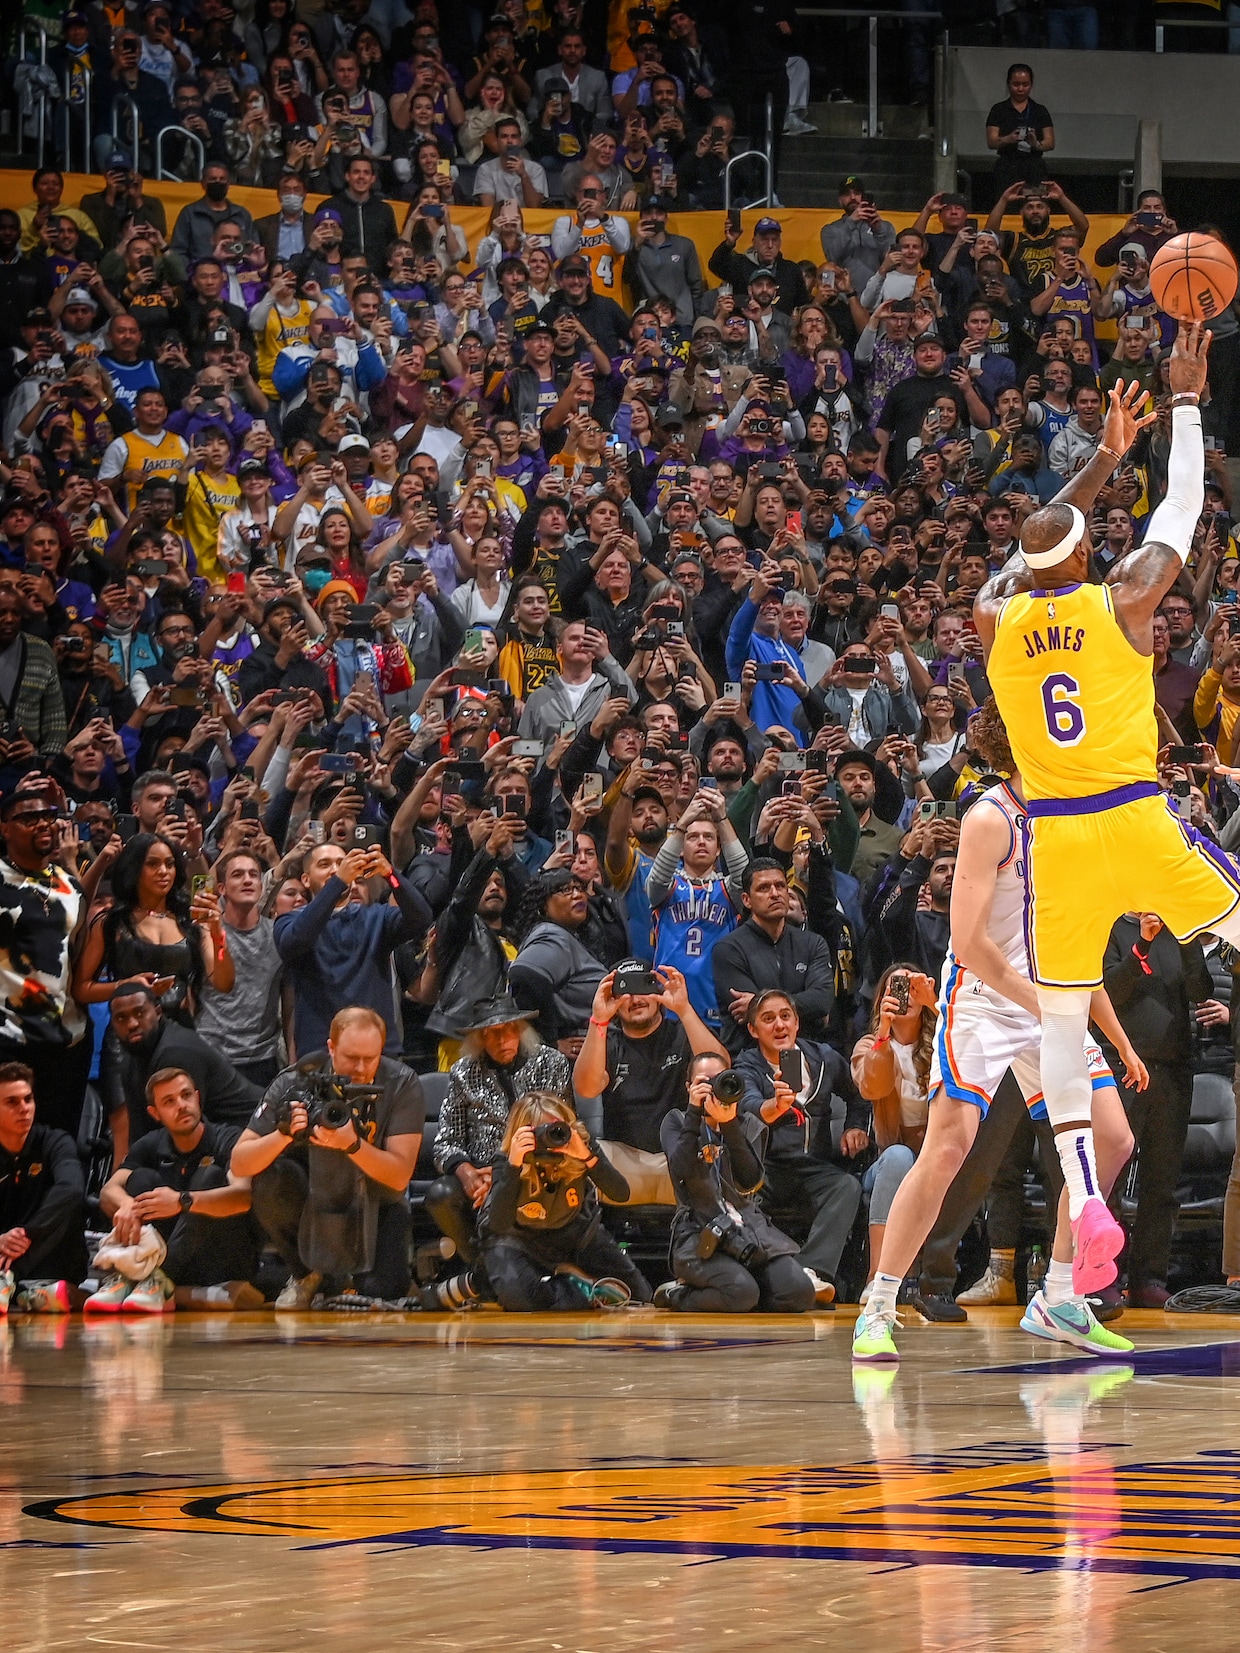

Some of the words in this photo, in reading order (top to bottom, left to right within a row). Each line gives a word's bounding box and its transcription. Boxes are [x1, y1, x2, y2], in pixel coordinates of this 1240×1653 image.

[142, 457, 183, 472] LAKERS
[206, 491, 238, 505] LAKER
[1023, 626, 1085, 659] JAMES
[1040, 671, 1087, 749] 6
[668, 900, 728, 926] THUNDER
[686, 927, 703, 956] 2
[565, 1187, 579, 1208] 6
